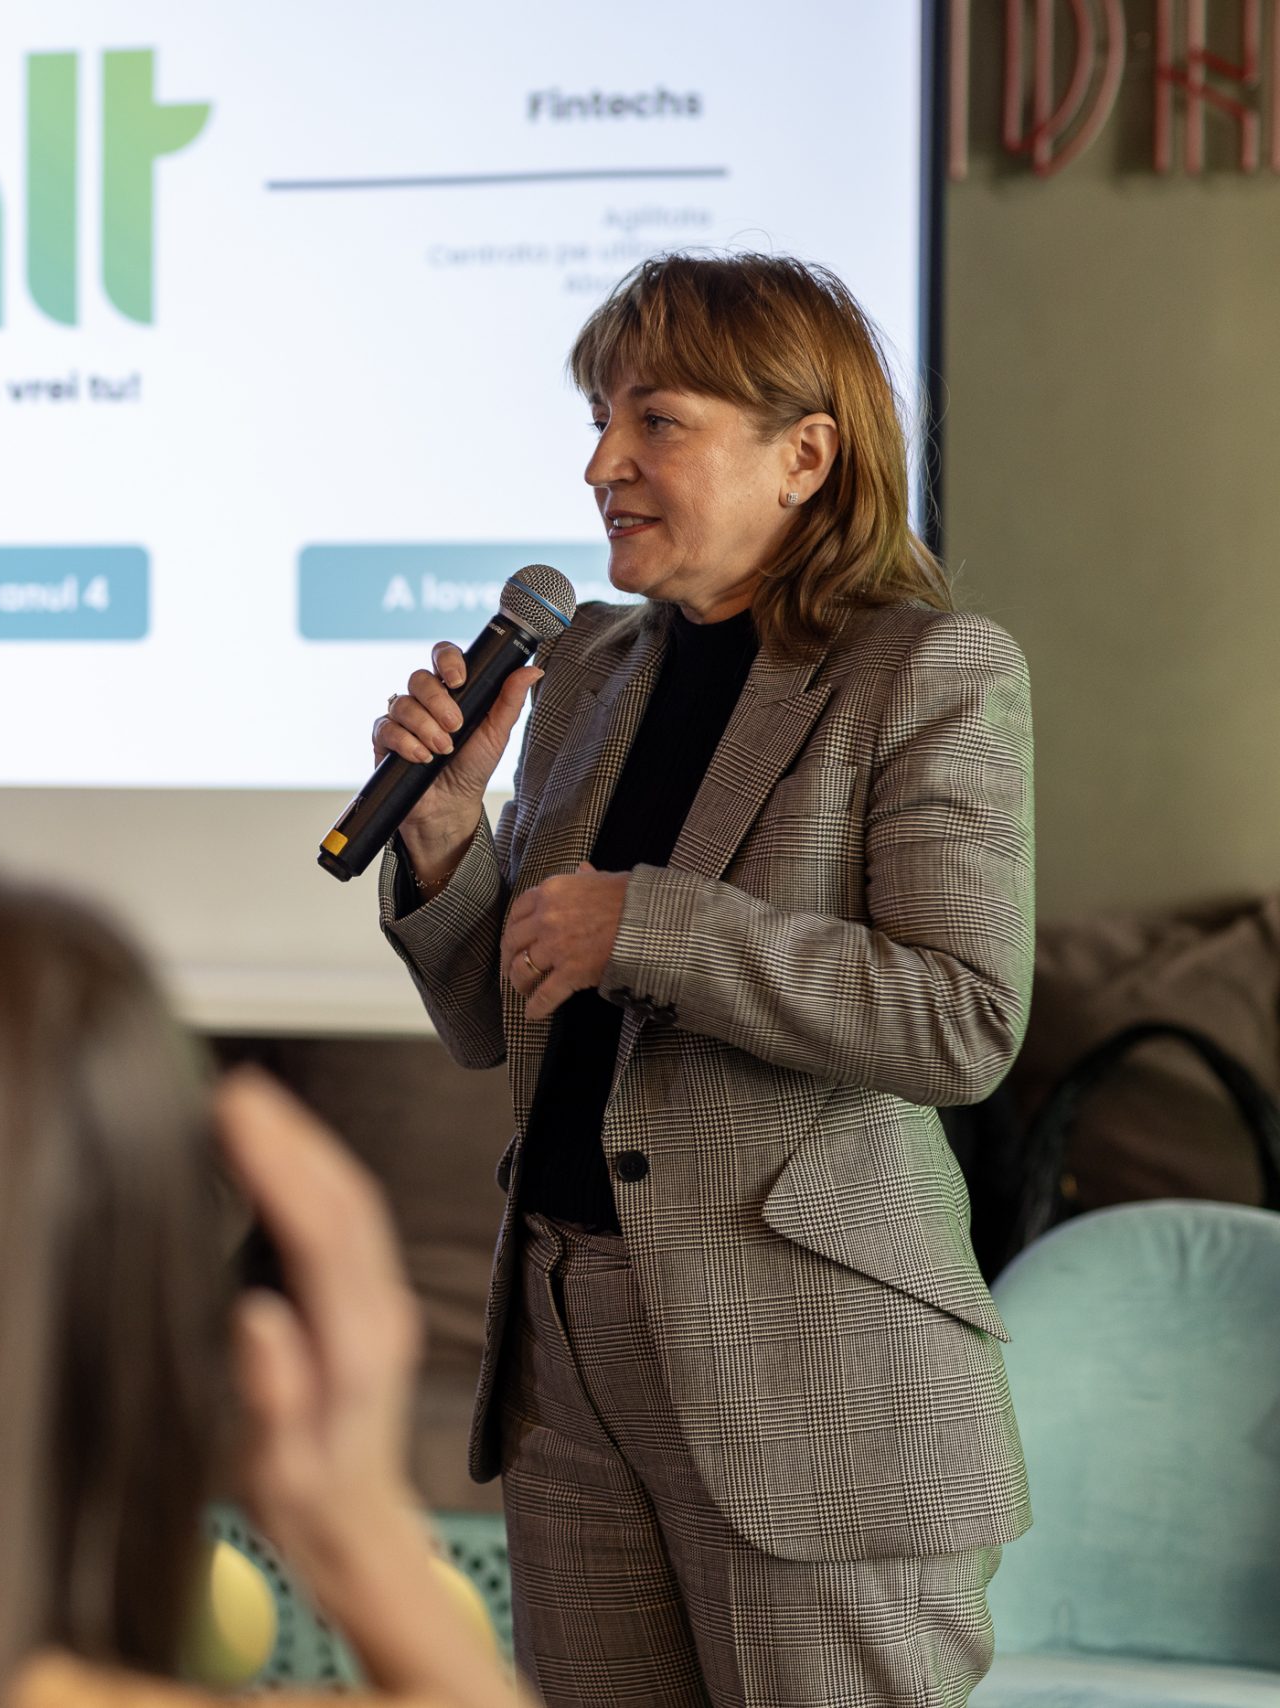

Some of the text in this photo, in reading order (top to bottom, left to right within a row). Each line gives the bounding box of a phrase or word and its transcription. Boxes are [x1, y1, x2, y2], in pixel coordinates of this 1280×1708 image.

[528, 88, 700, 121] Fintechs
[8, 371, 77, 403] vrei
[83, 576, 110, 610] 4
[383, 574, 414, 611] A
